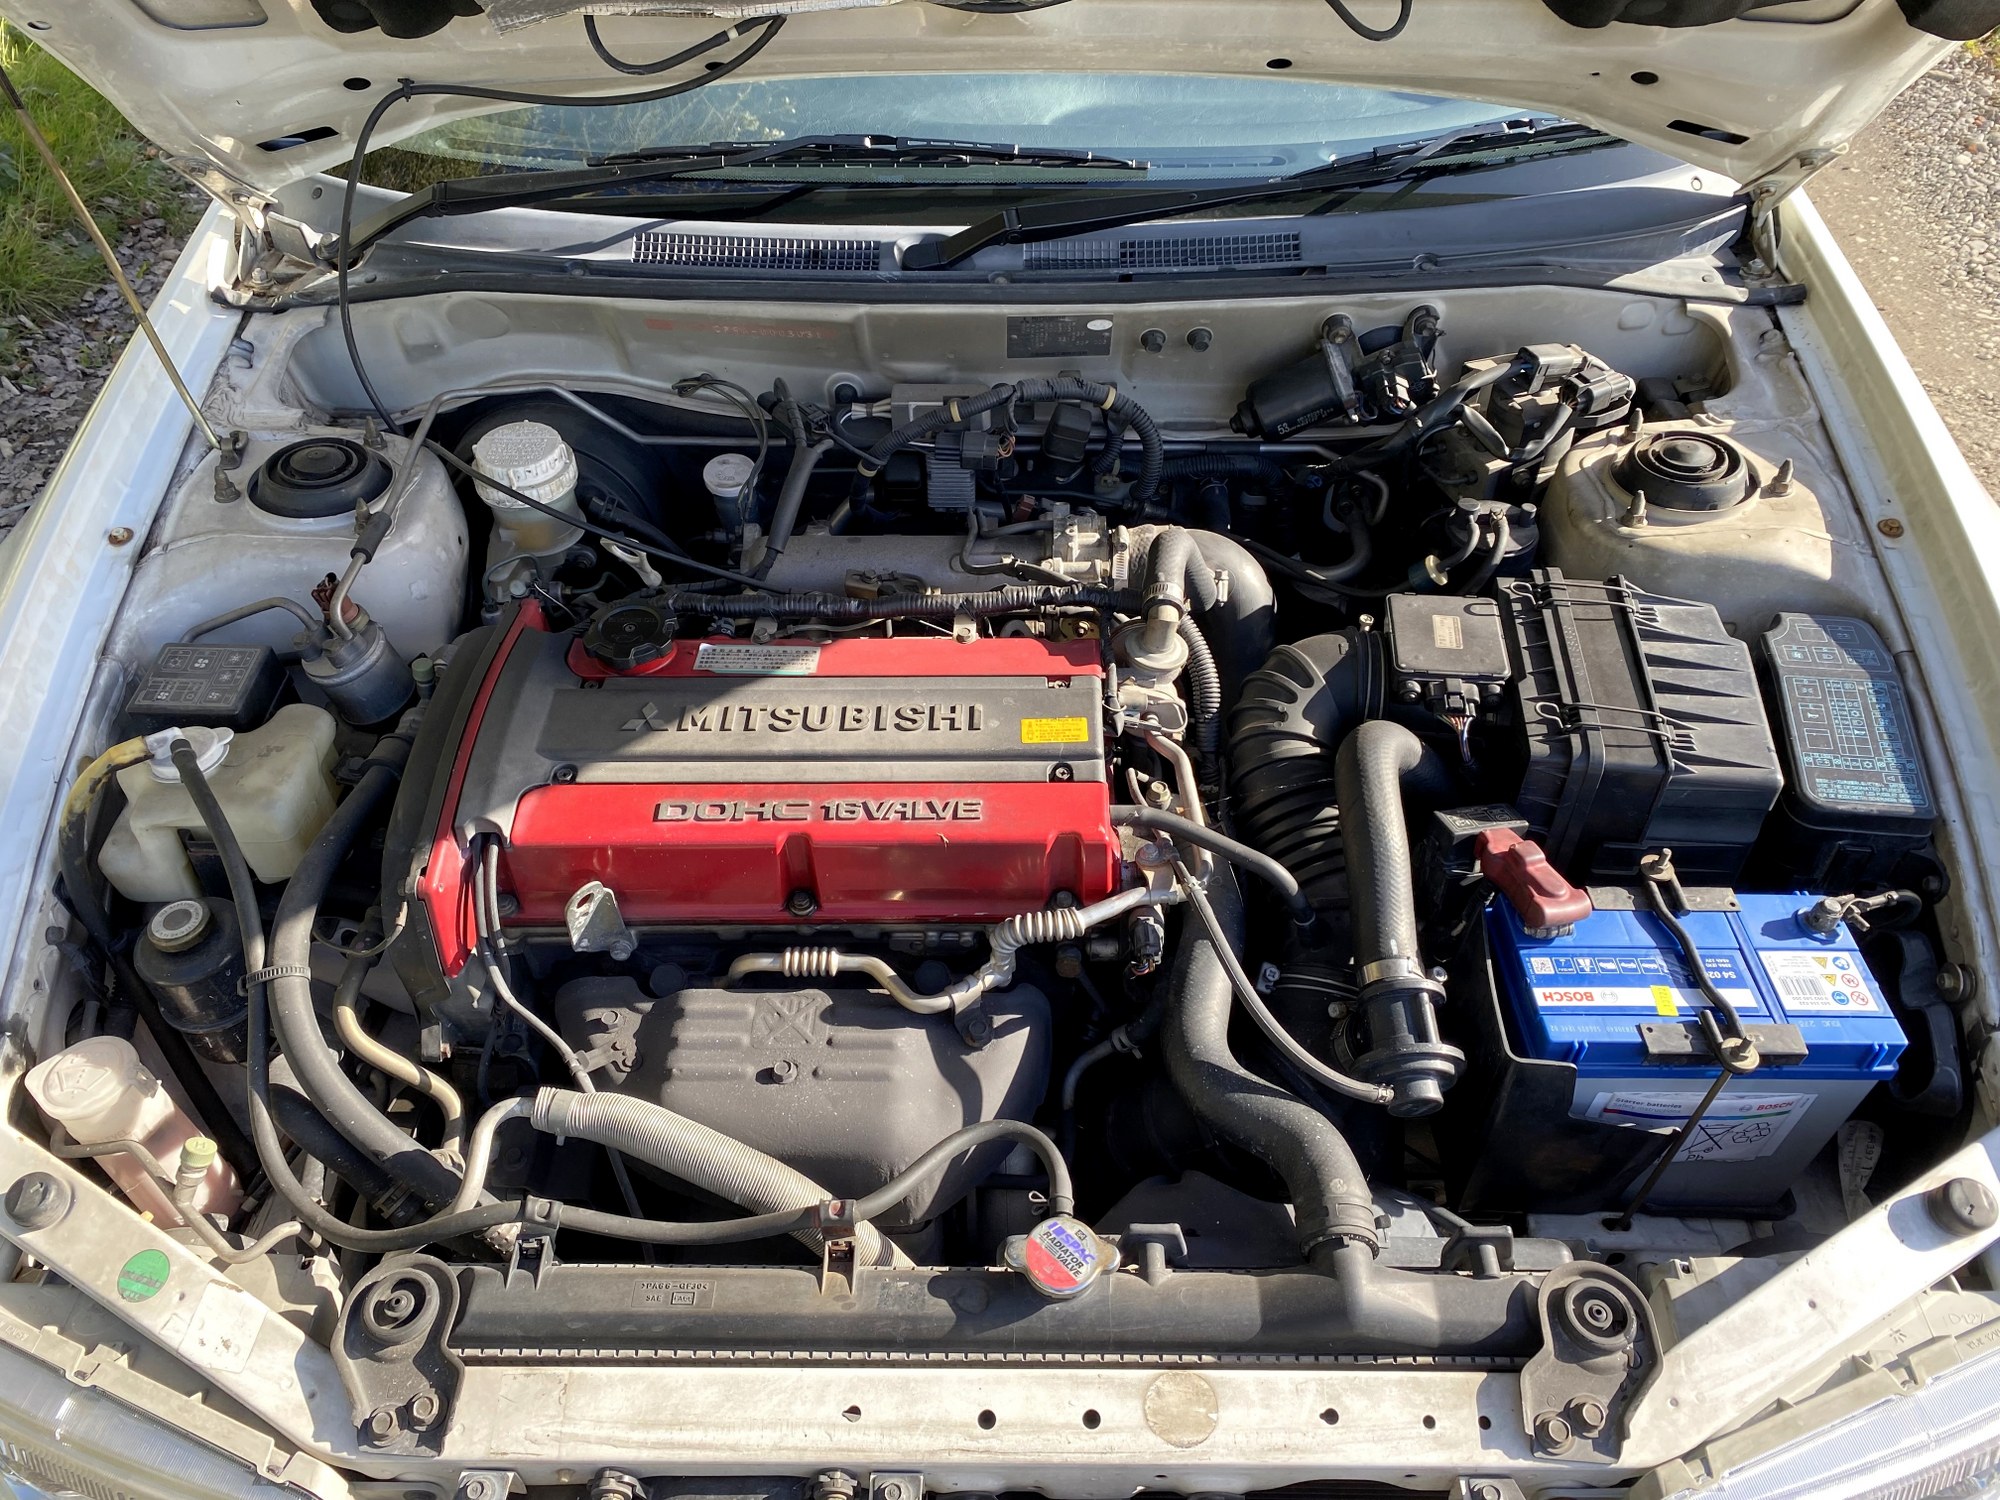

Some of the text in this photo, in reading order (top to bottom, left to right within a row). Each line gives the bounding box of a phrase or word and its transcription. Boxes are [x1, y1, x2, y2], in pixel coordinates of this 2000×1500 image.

[676, 703, 984, 732] MITSUBISHI
[652, 799, 812, 823] DOHC
[1722, 971, 1737, 979] S4
[1542, 991, 1595, 1002] BOSCH
[1615, 1097, 1645, 1106] Starter
[1756, 1101, 1794, 1111] BOSCH
[1043, 1231, 1085, 1269] RADIATOR
[1056, 1254, 1082, 1277] VALVE
